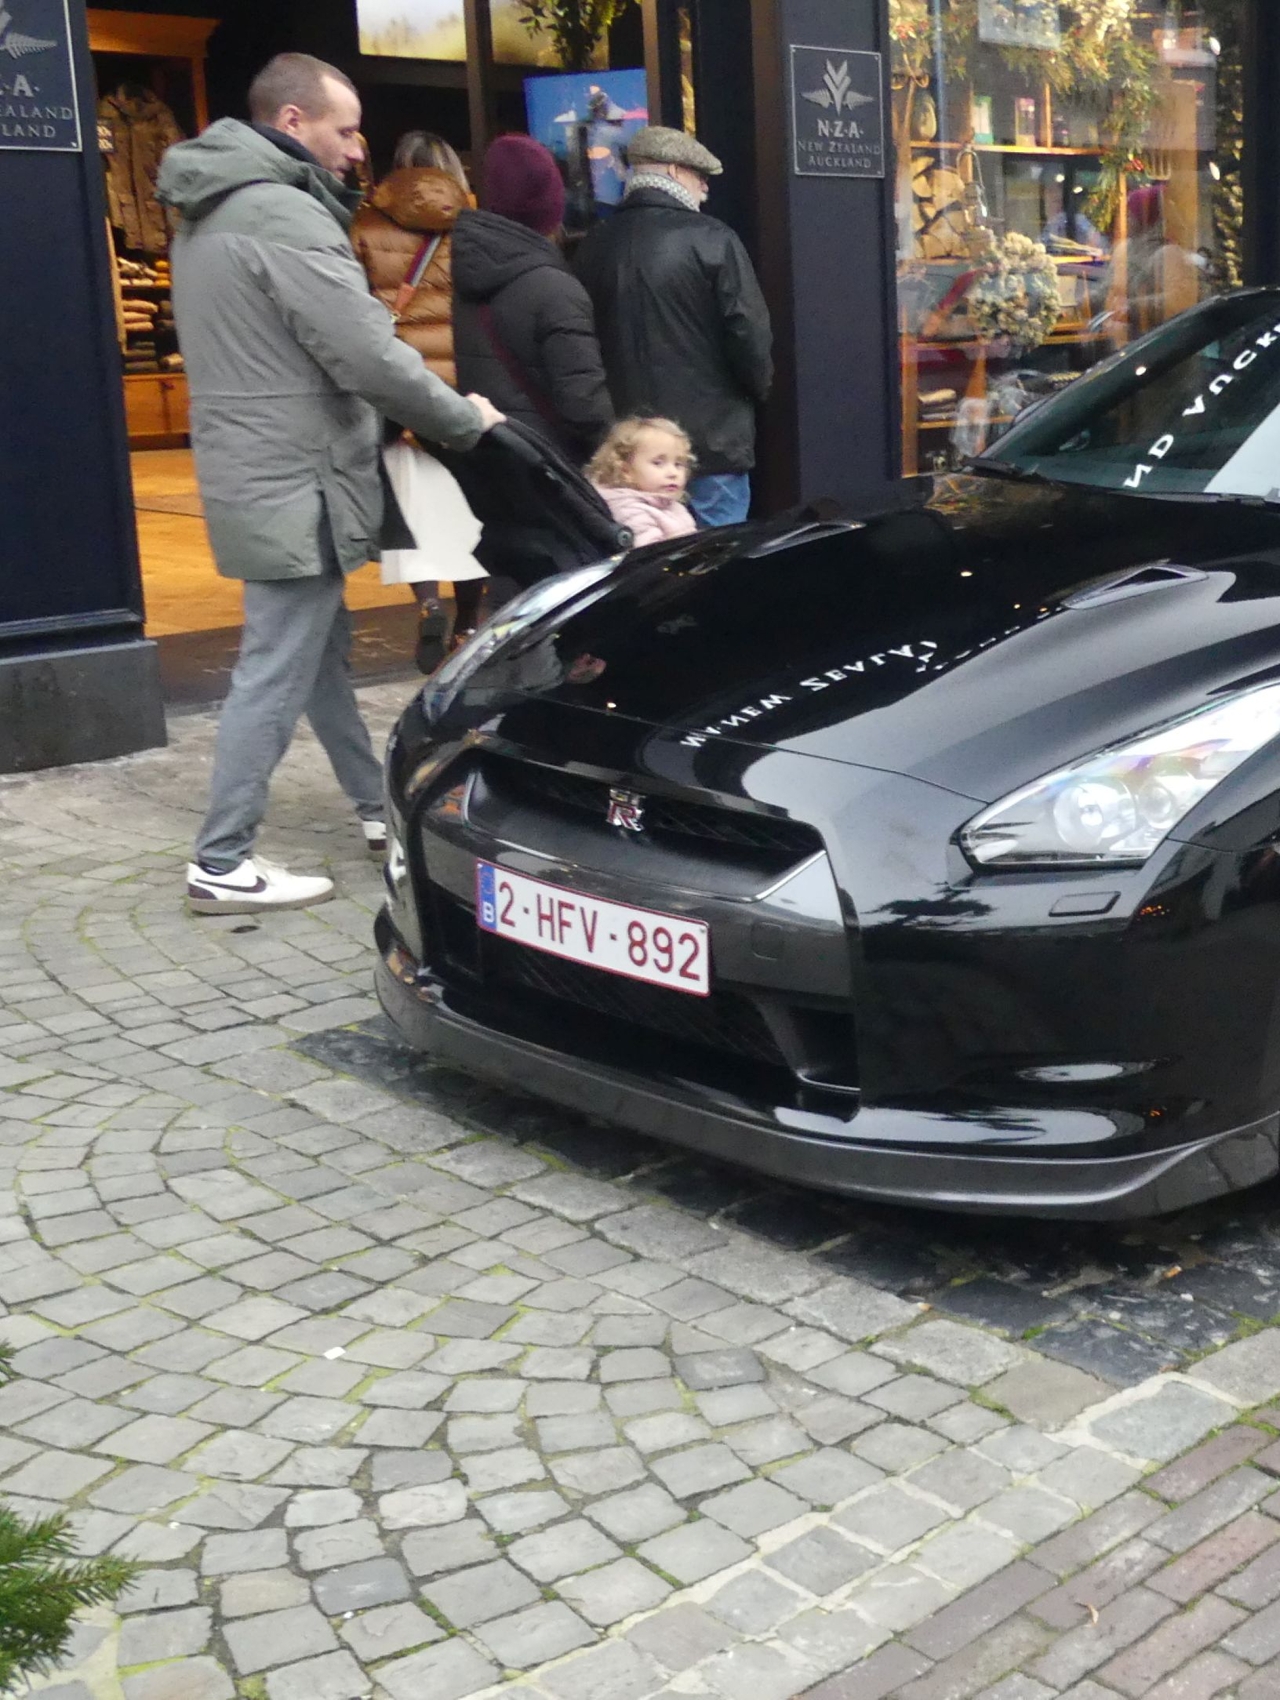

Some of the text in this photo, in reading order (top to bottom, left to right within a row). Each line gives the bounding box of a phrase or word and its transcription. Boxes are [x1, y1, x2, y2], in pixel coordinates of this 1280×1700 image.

[798, 141, 881, 155] NEW ZEALAND
[808, 155, 872, 168] AUCKLAND
[483, 902, 494, 923] B
